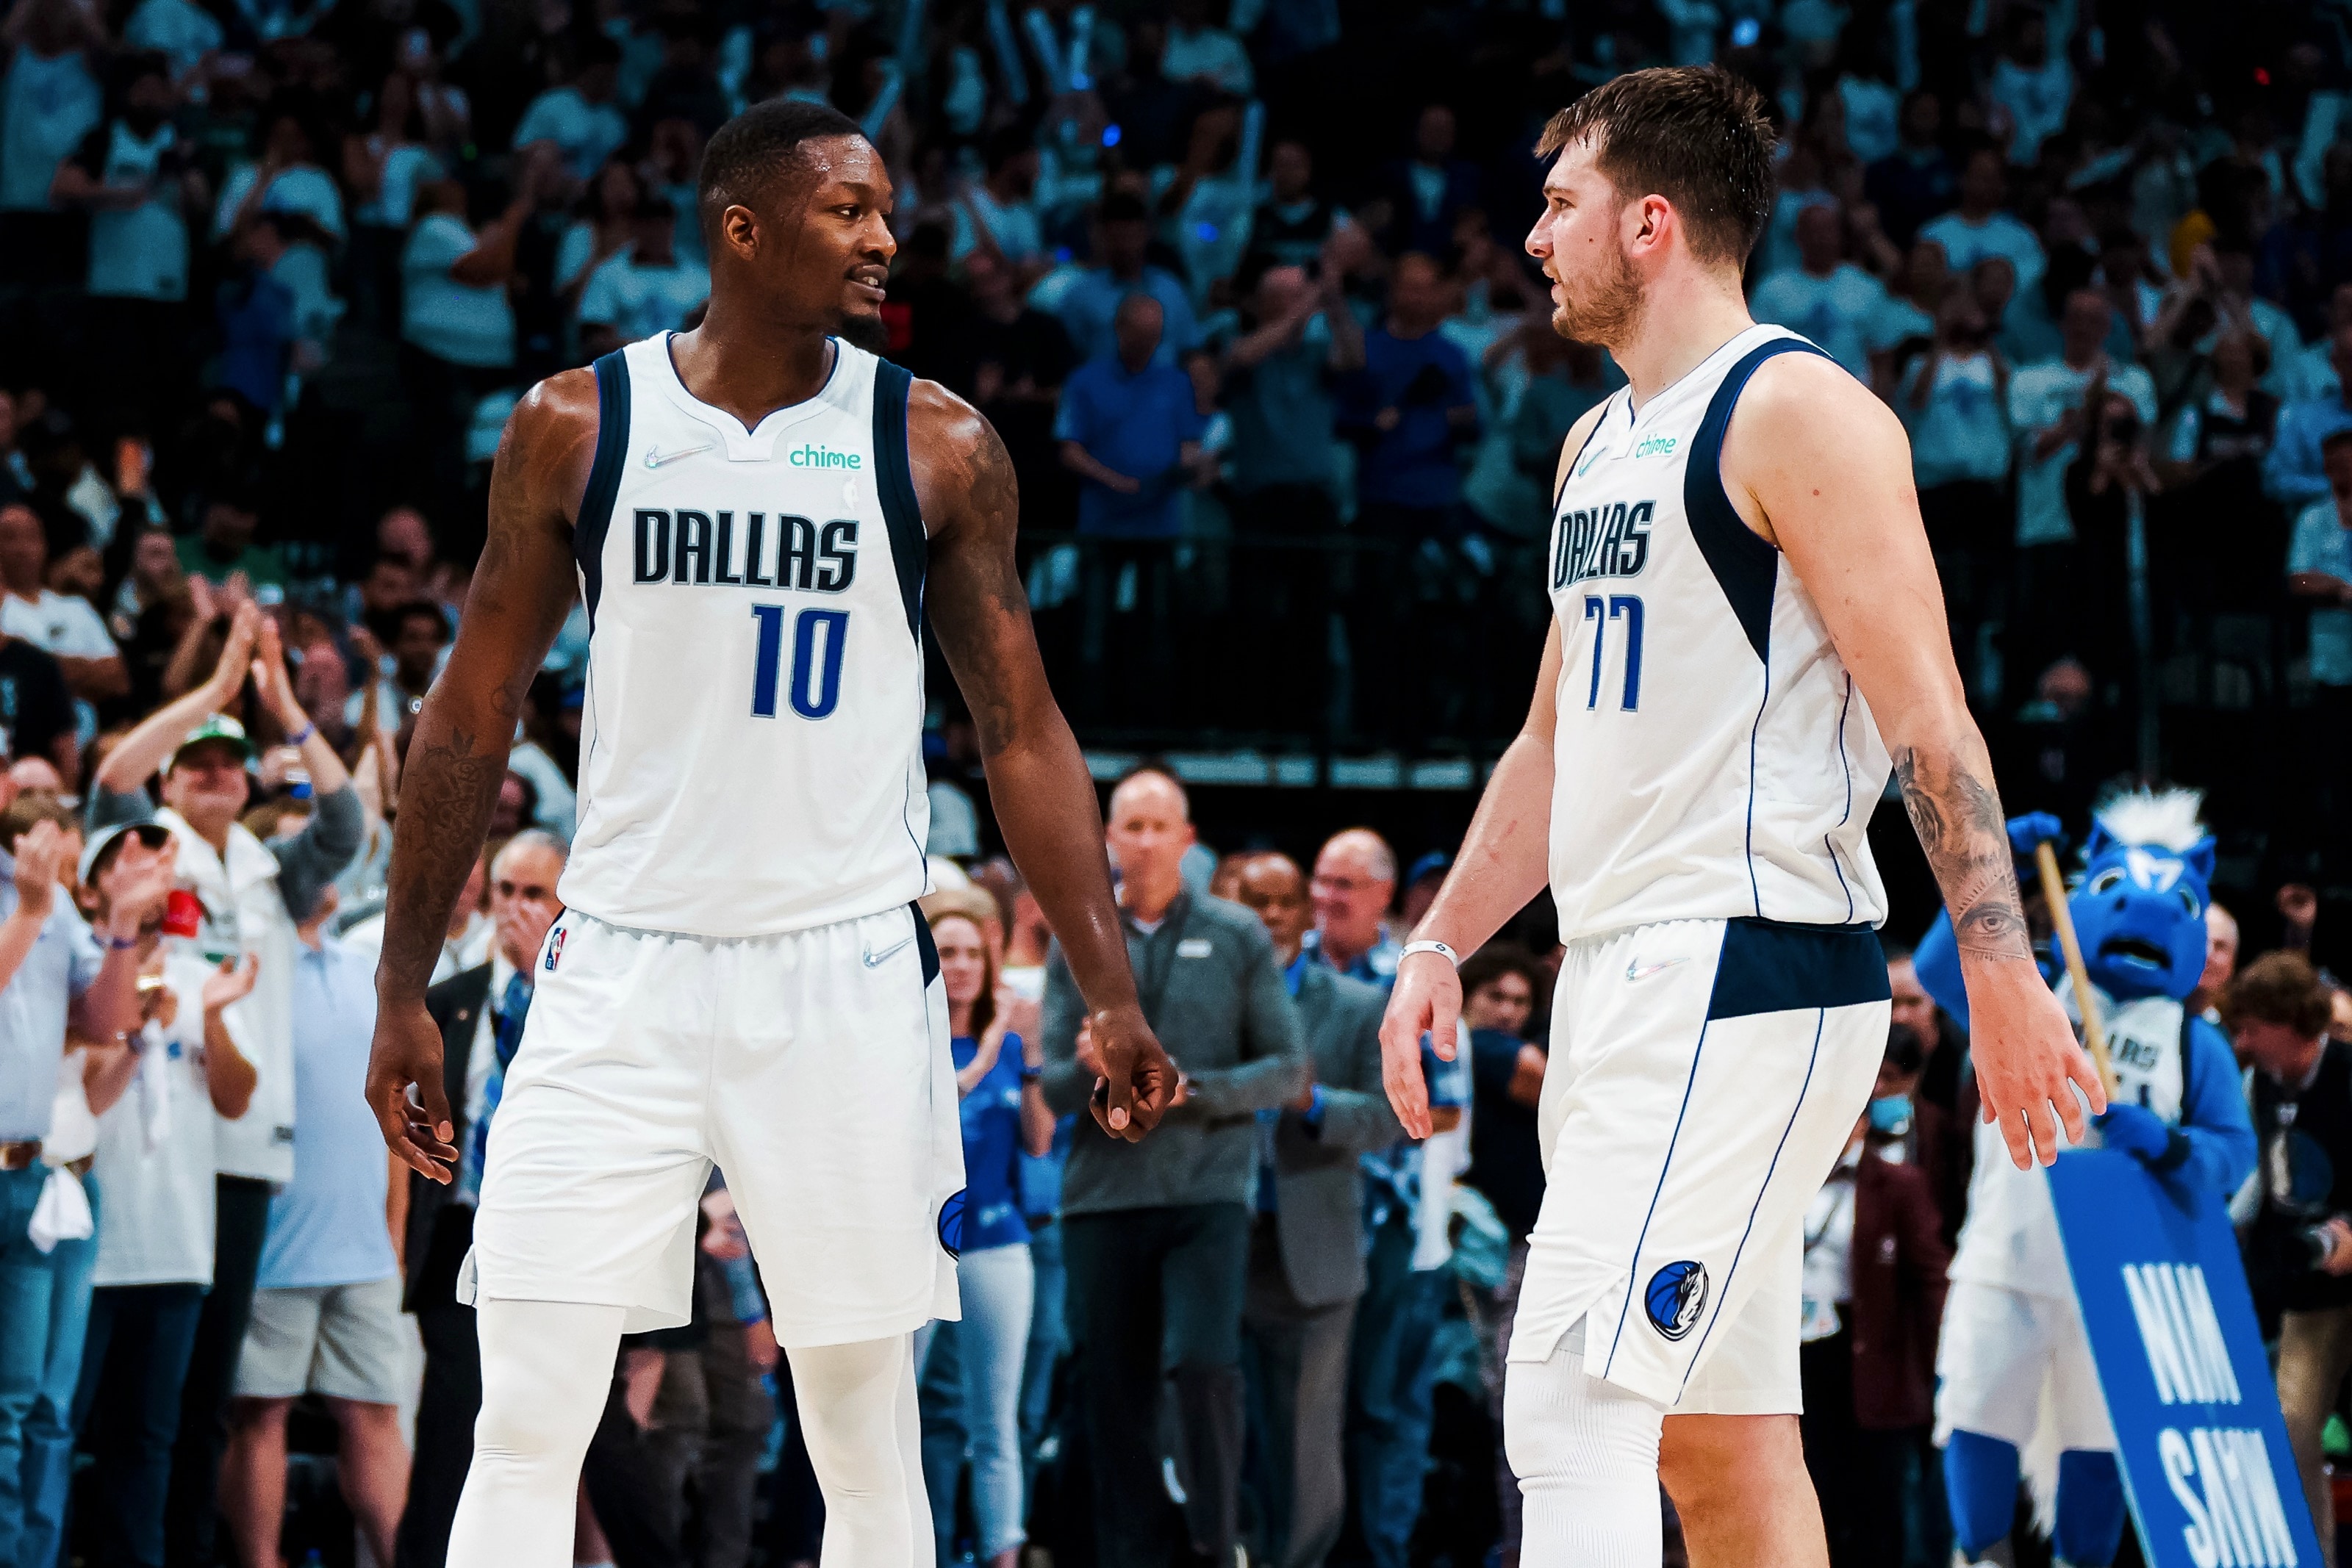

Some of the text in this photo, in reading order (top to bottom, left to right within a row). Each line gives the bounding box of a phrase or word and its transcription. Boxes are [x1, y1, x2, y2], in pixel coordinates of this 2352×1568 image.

[789, 444, 861, 470] chime
[1636, 434, 1676, 458] chime
[633, 507, 860, 594] DALLAS
[1553, 500, 1657, 593] DALLAS
[750, 603, 850, 721] 10
[1584, 594, 1646, 713] 77
